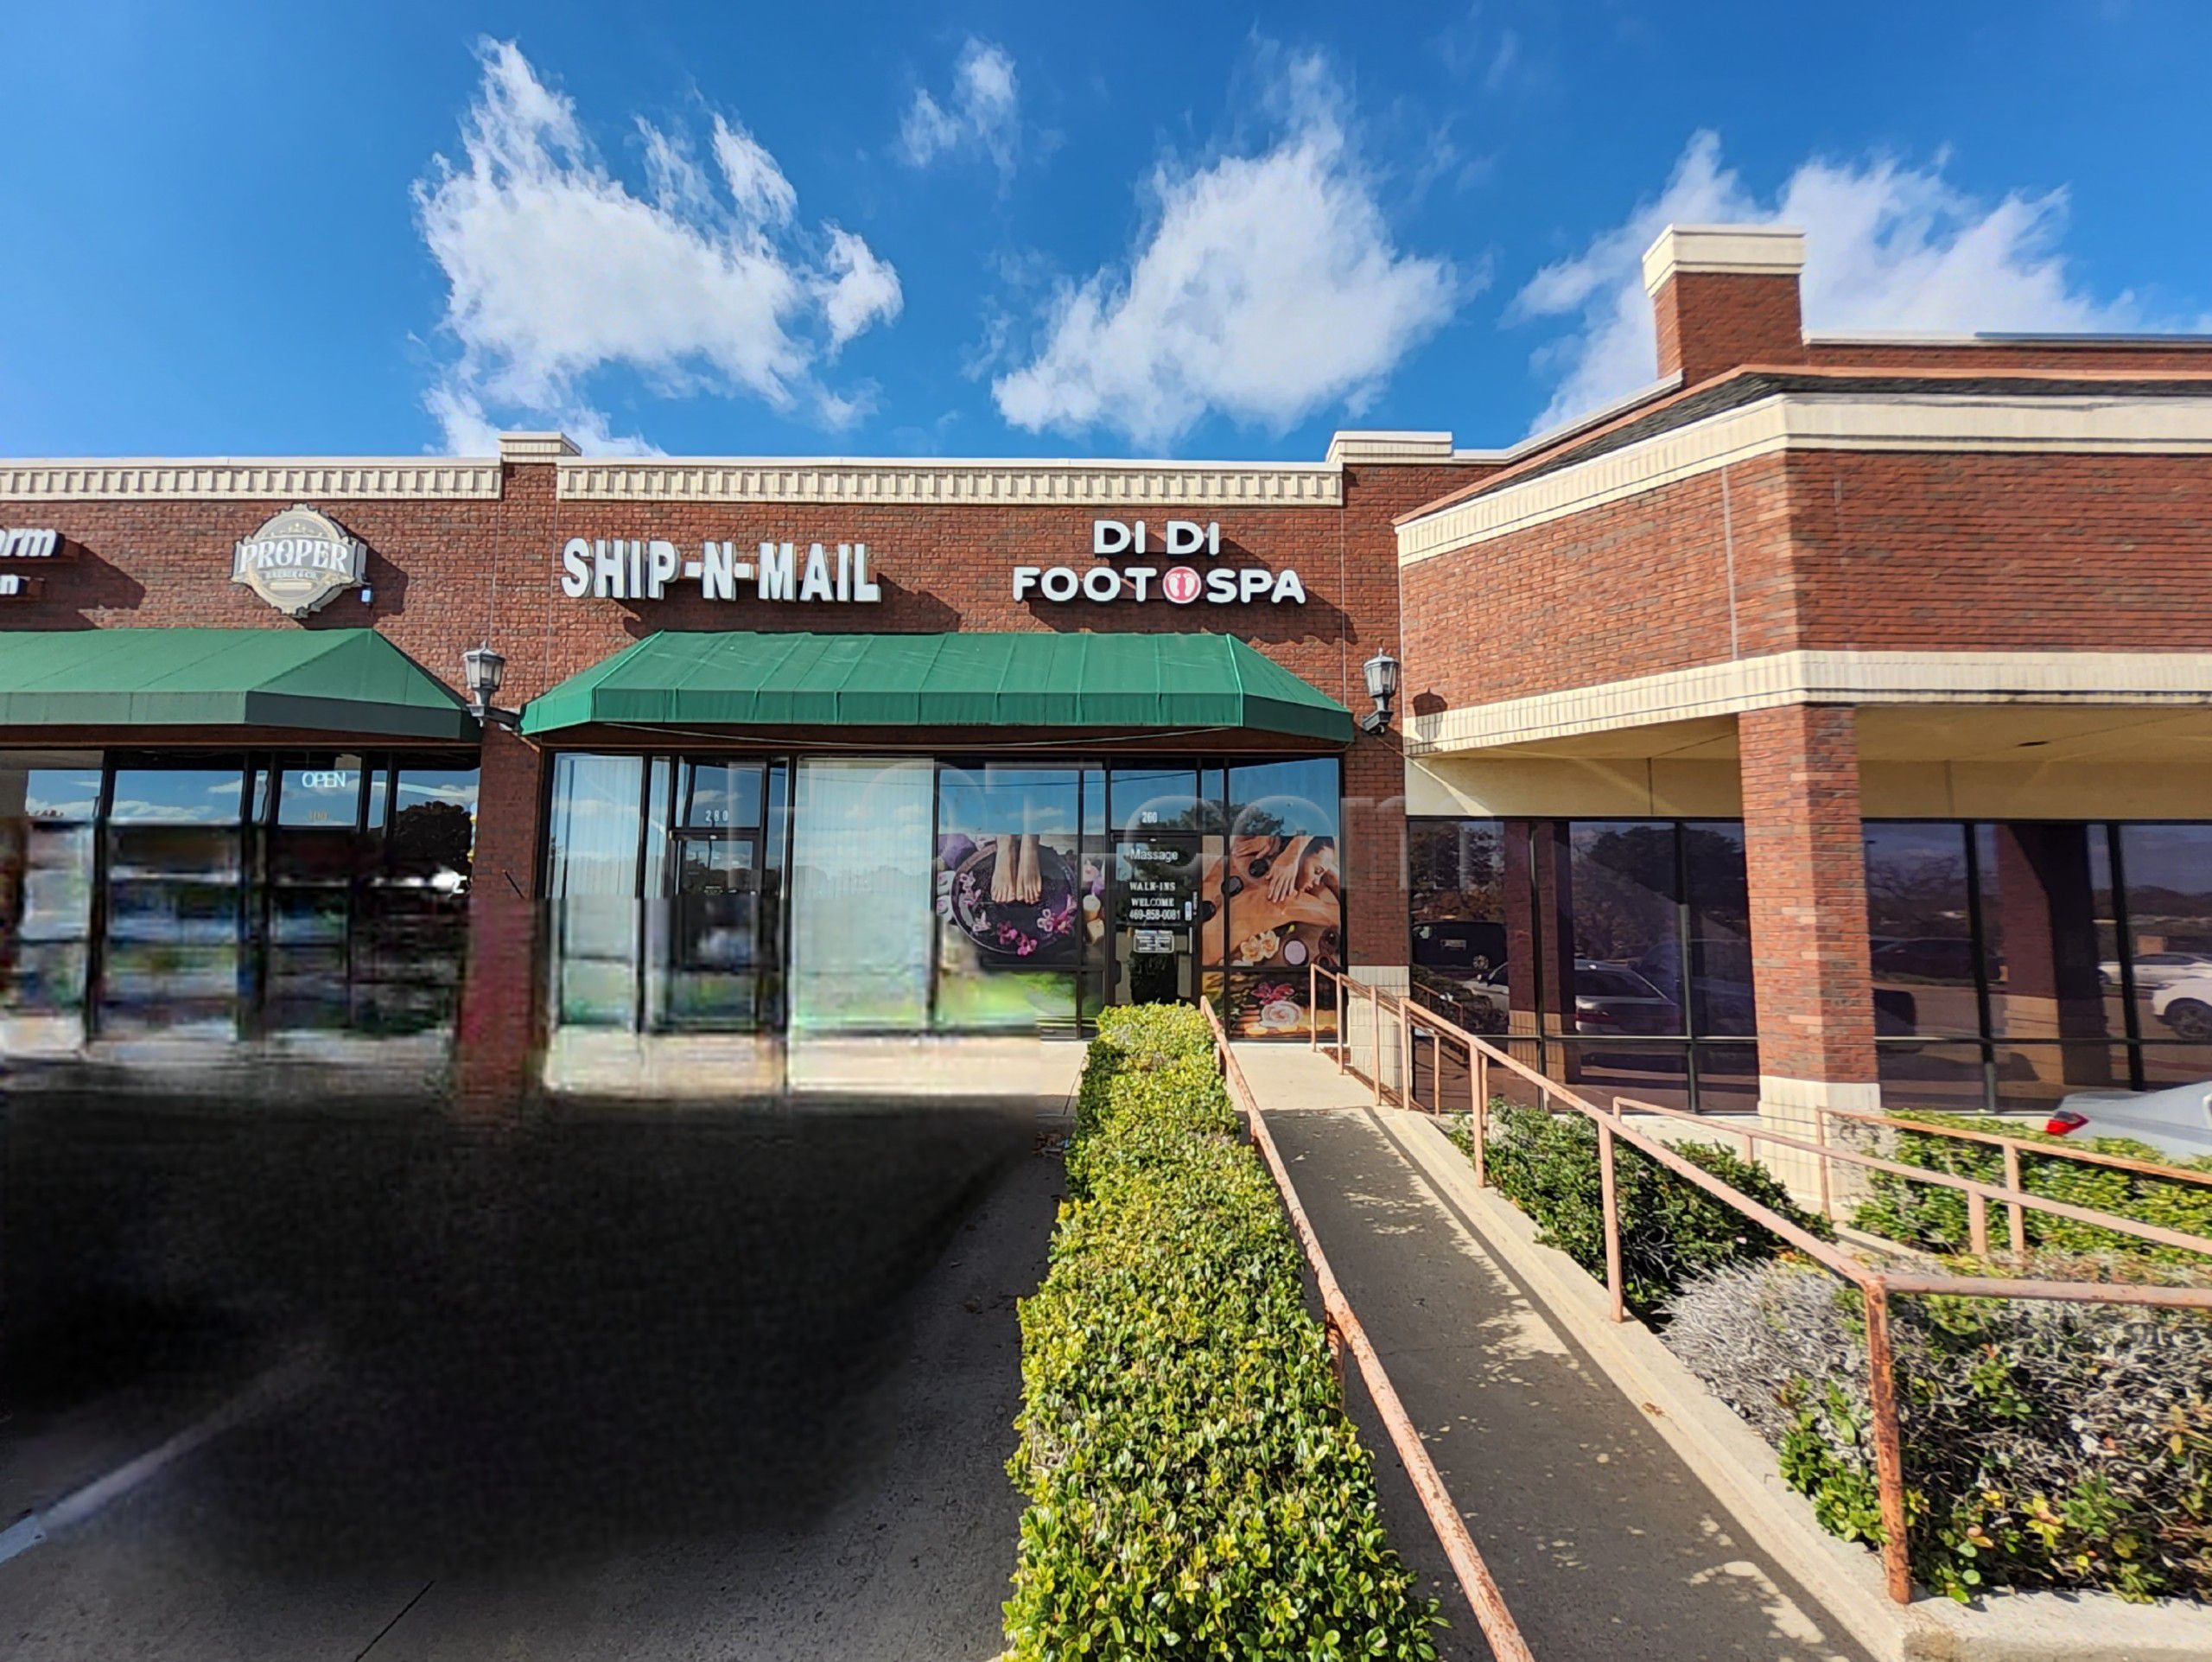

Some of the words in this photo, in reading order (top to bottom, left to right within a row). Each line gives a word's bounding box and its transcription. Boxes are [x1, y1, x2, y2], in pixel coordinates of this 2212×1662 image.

[1093, 519, 1145, 556] DI
[1166, 520, 1219, 557] DI
[238, 538, 348, 575] PROPER
[560, 537, 881, 603] SHIP-N-MAIL
[1013, 566, 1157, 602] FOOT
[1206, 568, 1306, 604] SPA
[302, 771, 346, 788] OPEN
[1129, 848, 1179, 863] Massage
[1128, 882, 1176, 892] WALK-INS
[1130, 897, 1175, 907] WELCOME
